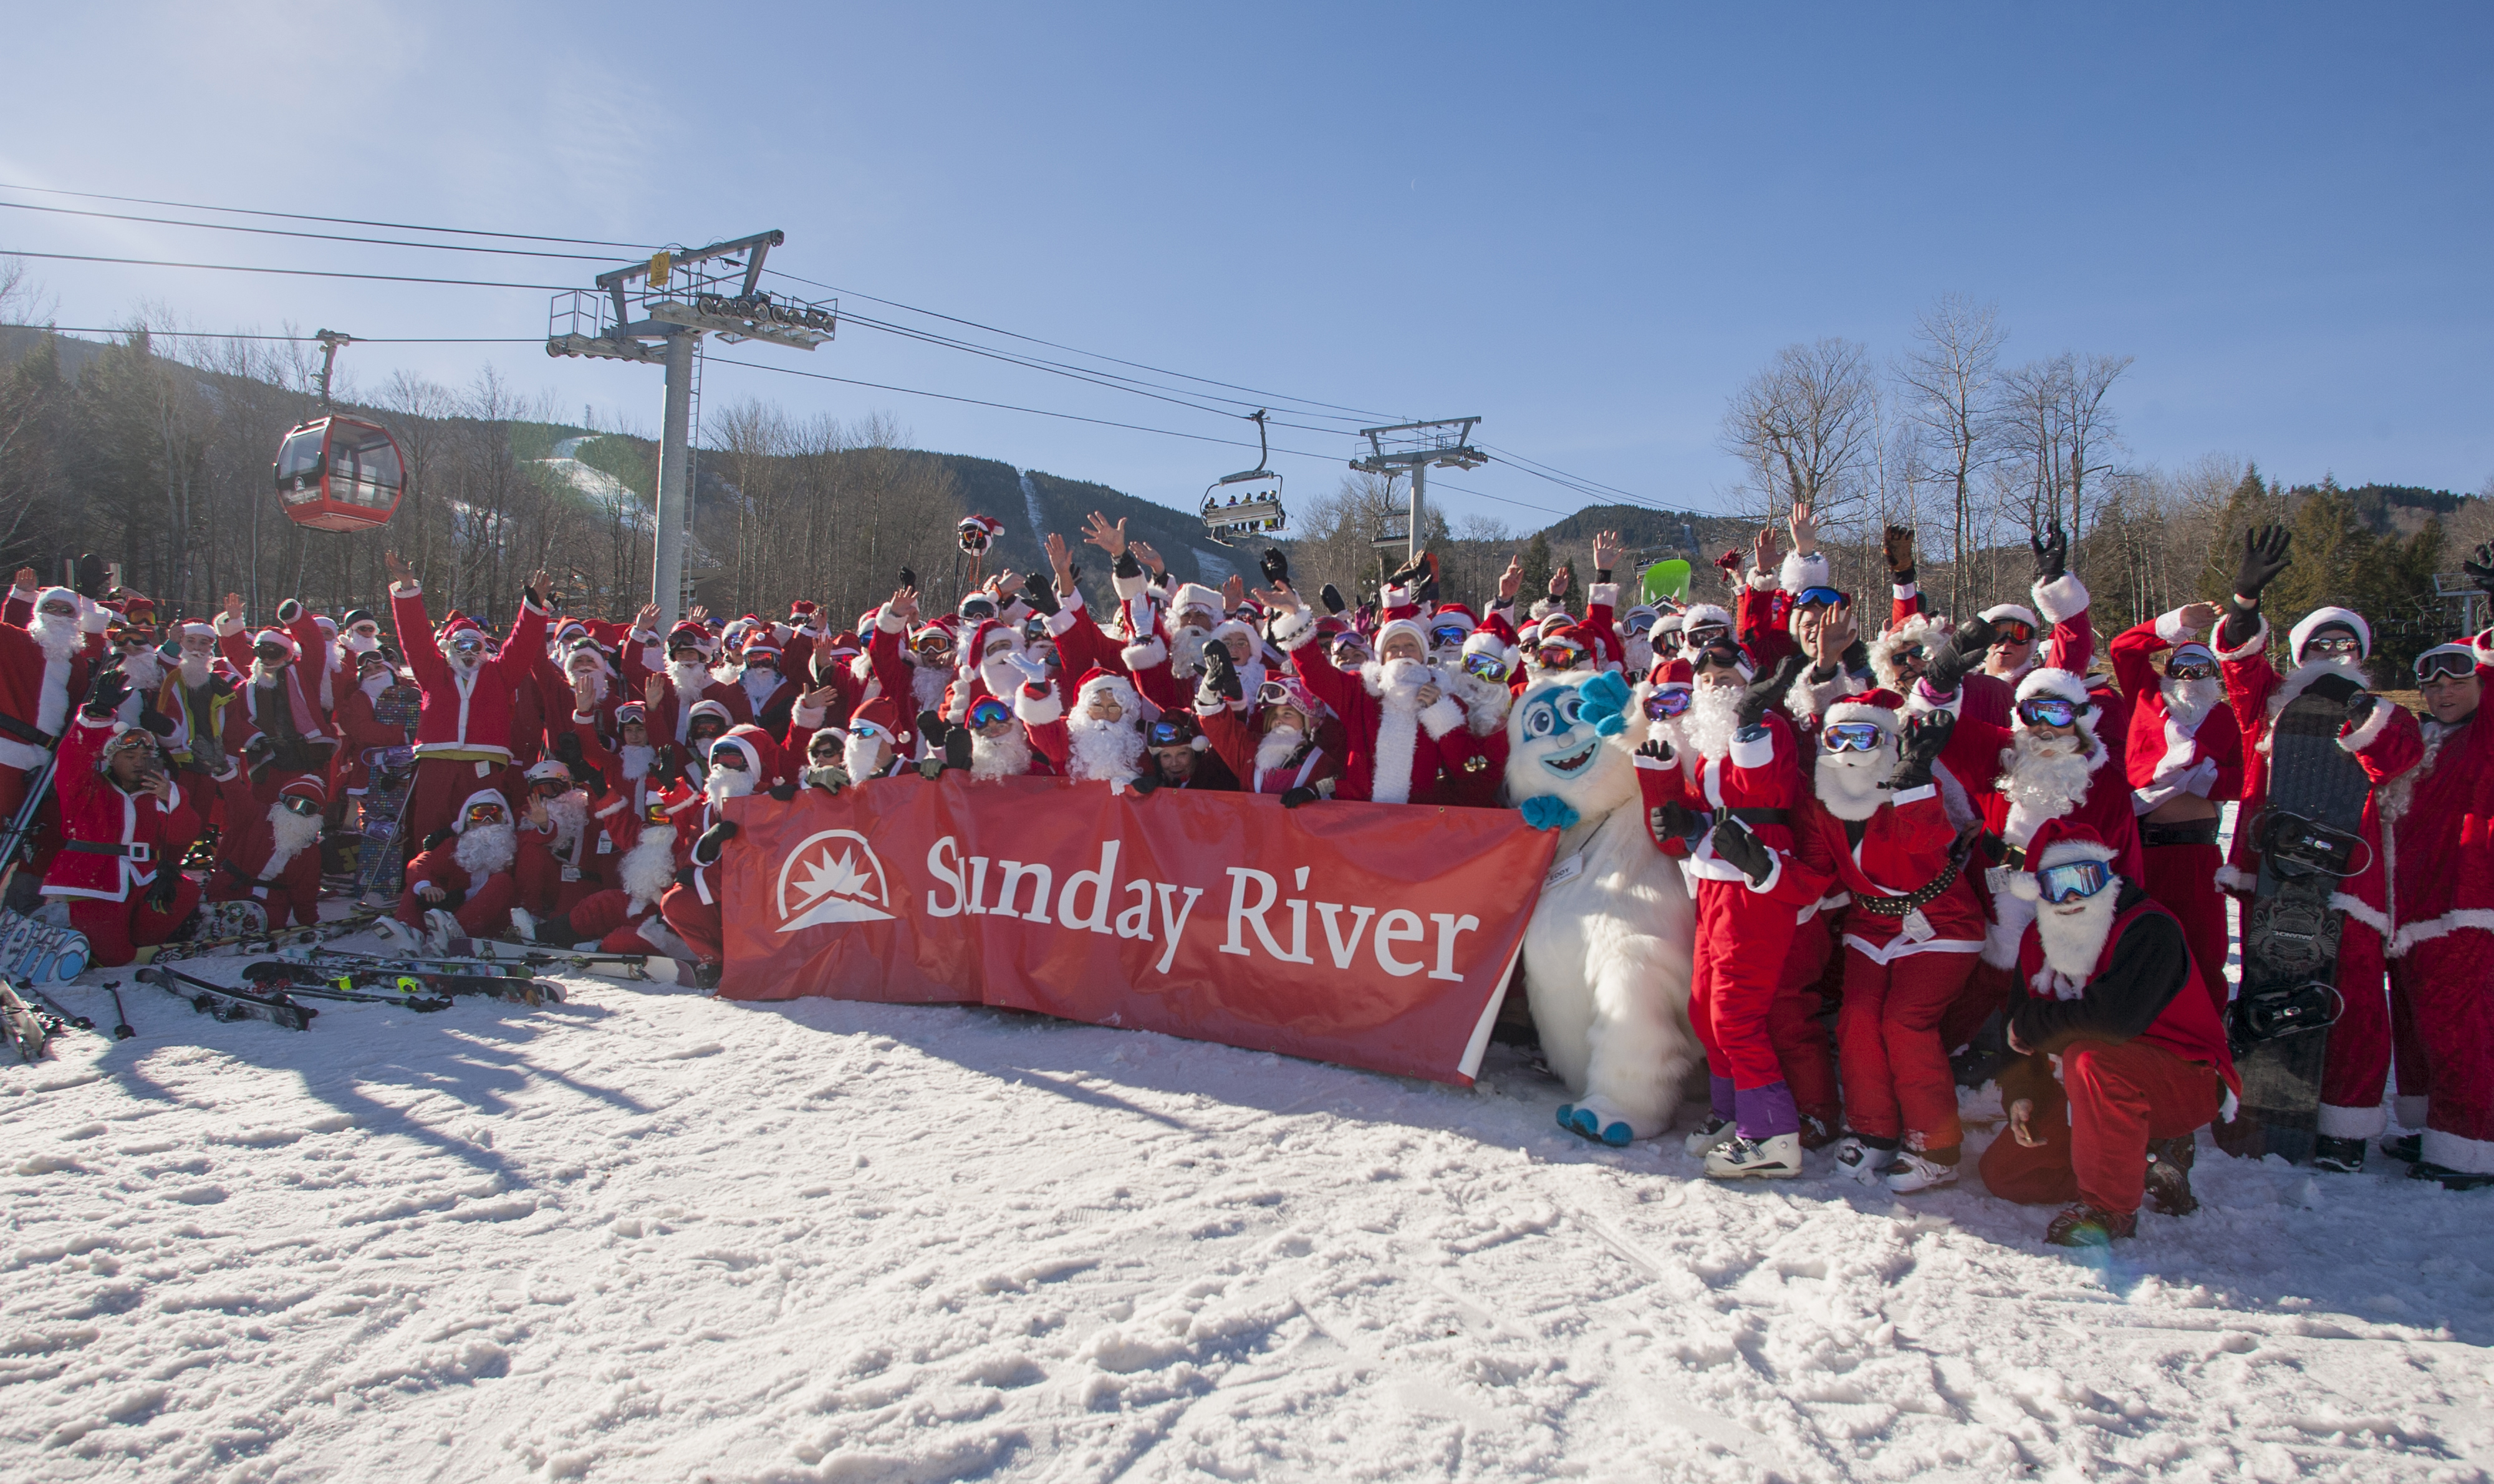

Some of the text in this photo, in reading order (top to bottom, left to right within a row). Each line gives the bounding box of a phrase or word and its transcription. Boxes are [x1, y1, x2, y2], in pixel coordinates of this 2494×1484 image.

[927, 836, 1480, 983] Sunday River
[2271, 930, 2314, 940] AVALANCHE
